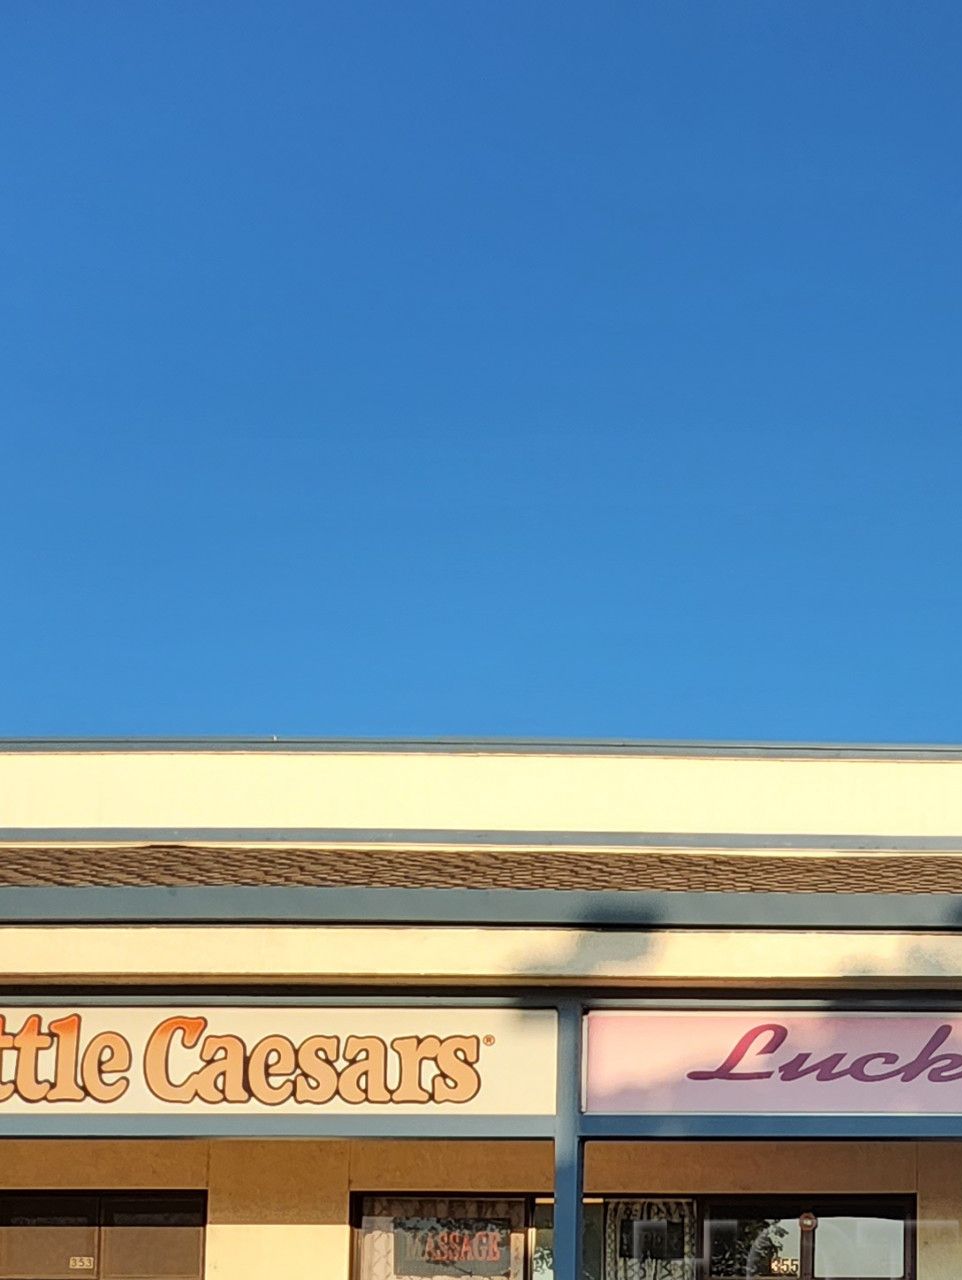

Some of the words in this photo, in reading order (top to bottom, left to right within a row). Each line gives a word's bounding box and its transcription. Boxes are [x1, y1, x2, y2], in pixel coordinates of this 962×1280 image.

[405, 1230, 501, 1262] MASSAGE
[71, 1257, 93, 1268] 353
[770, 1258, 799, 1274] 355
